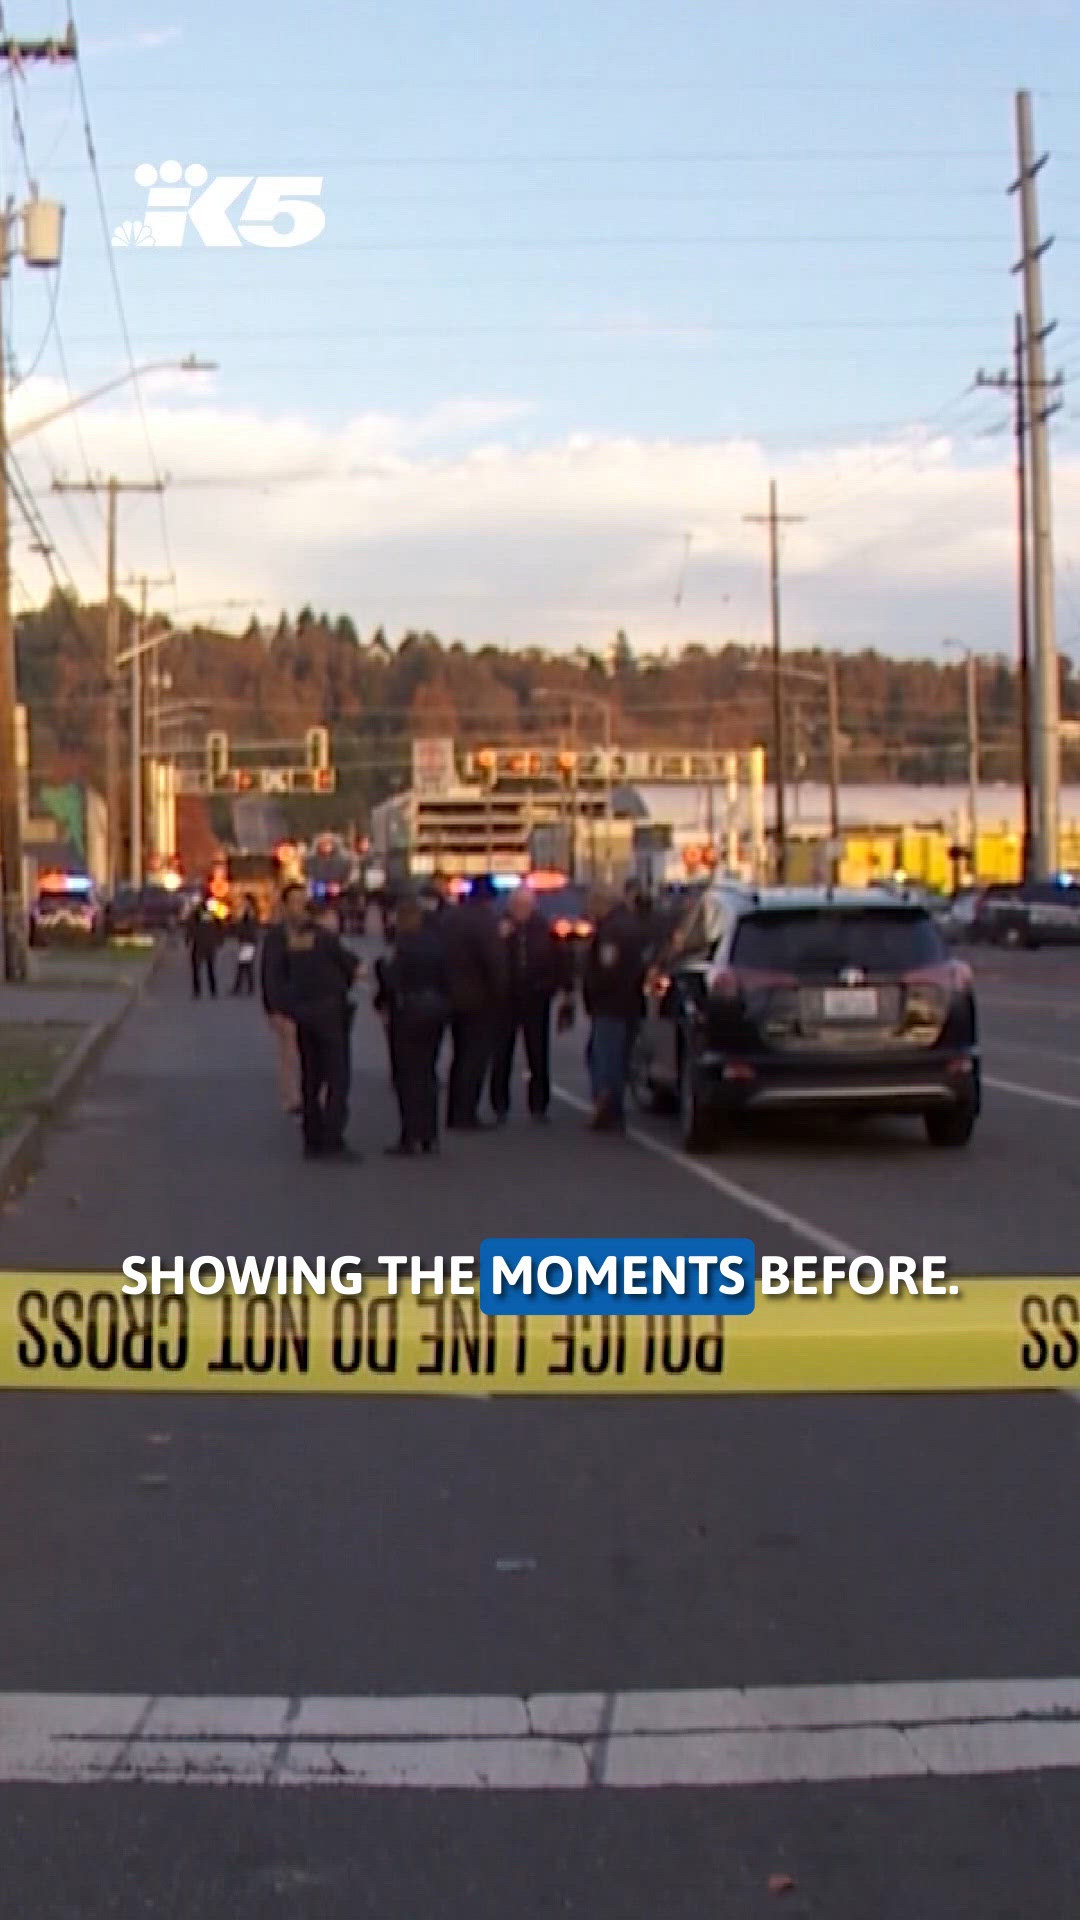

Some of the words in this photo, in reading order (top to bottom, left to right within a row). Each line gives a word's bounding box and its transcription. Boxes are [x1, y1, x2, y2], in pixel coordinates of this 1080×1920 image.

[17, 1290, 189, 1372] CROSS
[207, 1293, 310, 1374] NOT
[331, 1294, 399, 1375] DO
